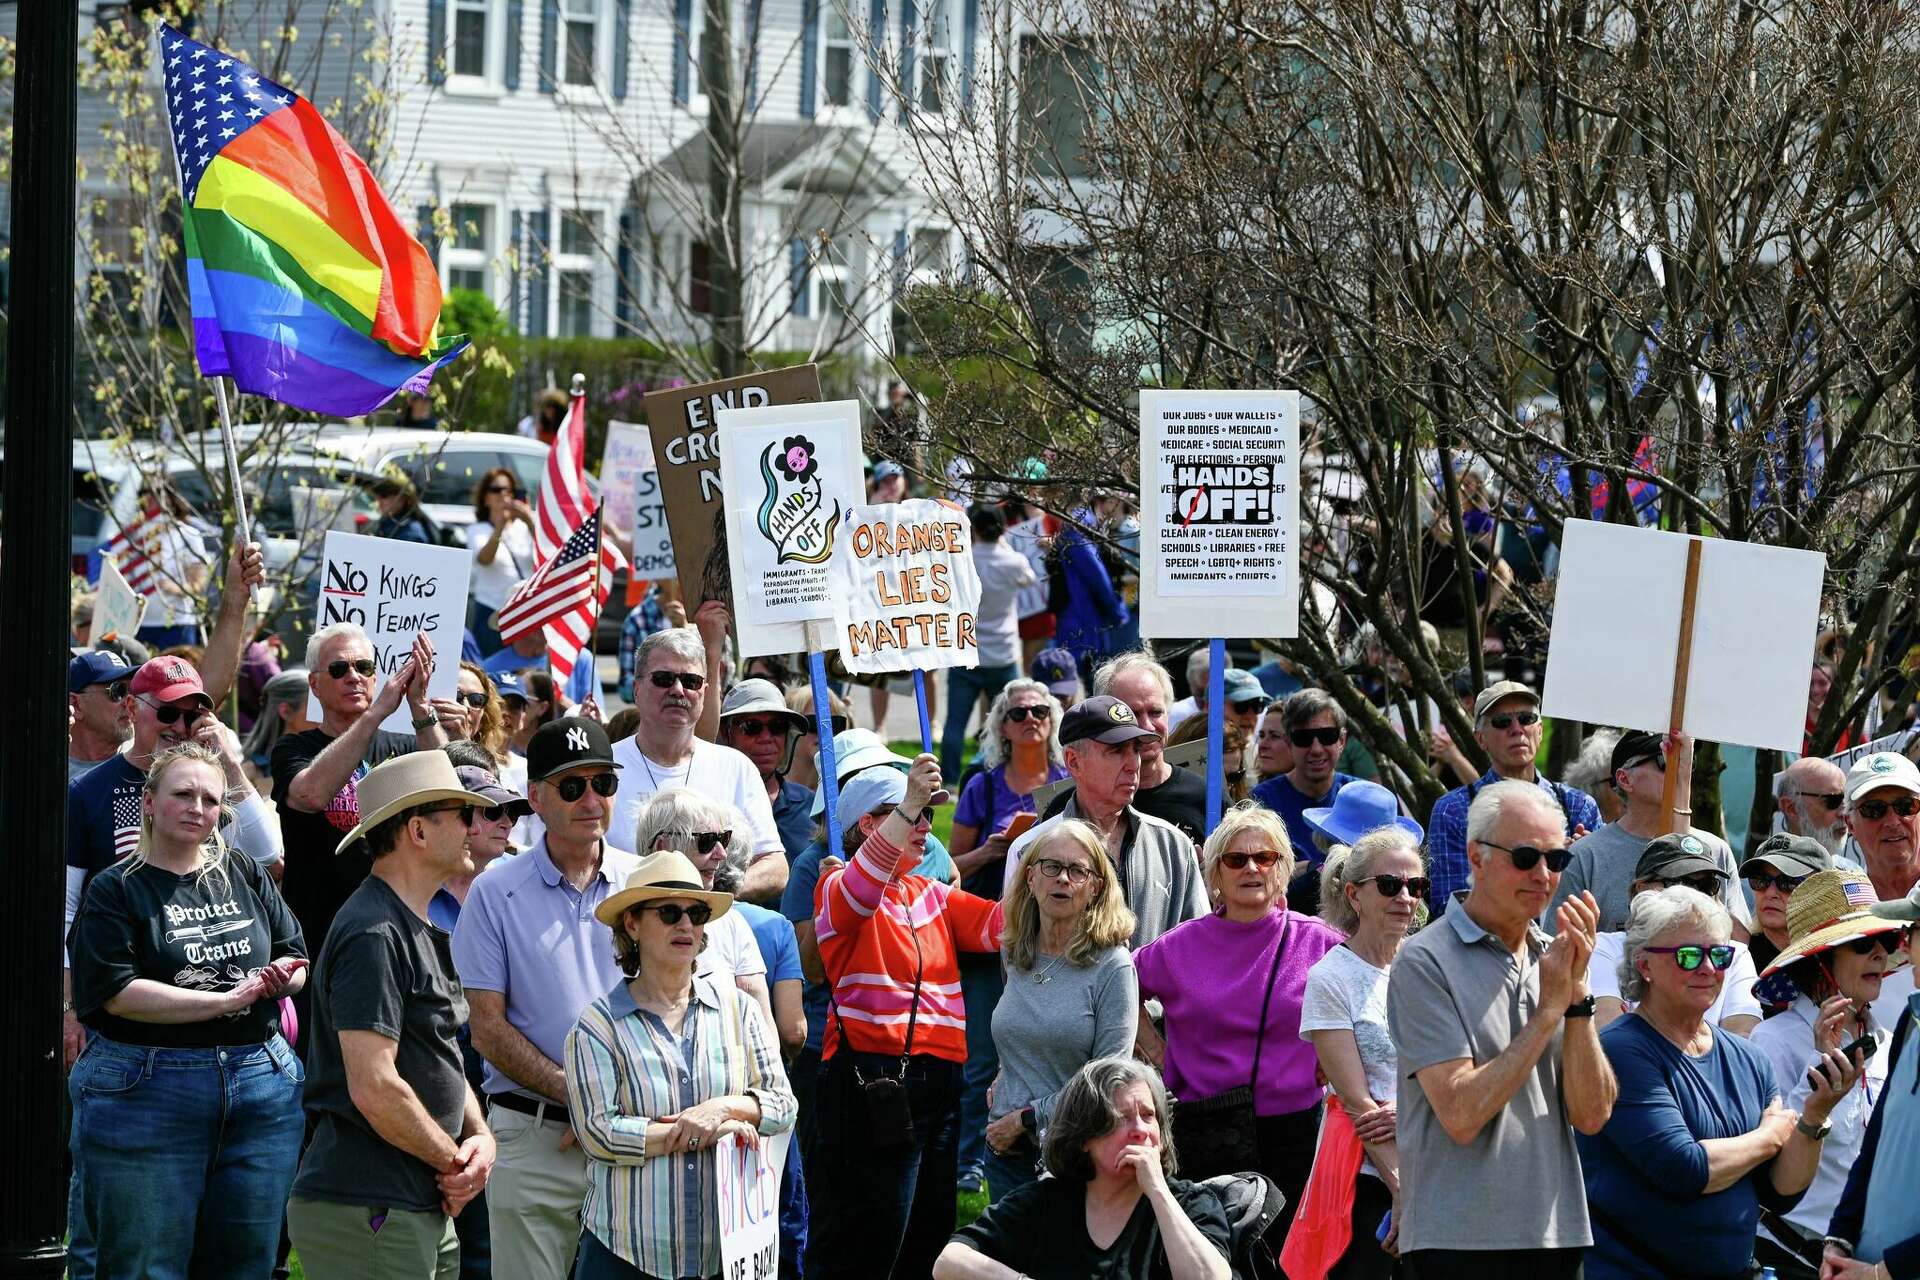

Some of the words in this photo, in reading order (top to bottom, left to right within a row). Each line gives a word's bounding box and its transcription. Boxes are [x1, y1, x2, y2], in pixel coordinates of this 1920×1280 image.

[1167, 425, 1185, 435] OUR
[1187, 425, 1220, 435] BODIES
[1228, 425, 1272, 435] MEDICAID
[1212, 439, 1244, 450] SOCIAL
[1165, 454, 1186, 464] FAIR
[1187, 454, 1234, 464] ELECTIONS
[1243, 454, 1286, 464] PERSONA
[1178, 466, 1270, 487] HANDS
[771, 486, 814, 535] HANDS
[1178, 488, 1270, 521] OFF!
[796, 517, 823, 552] OFF
[1161, 528, 1189, 538] CLEAN
[1190, 528, 1206, 538] AIR
[1215, 528, 1243, 538] CLEAN
[1245, 528, 1279, 538] ENERGY
[852, 521, 964, 559] ORANGE
[1161, 543, 1201, 553] SCHOOLS
[1210, 543, 1256, 553] LIBRARIES
[1264, 543, 1286, 553] FREE
[1165, 558, 1199, 568] SPEECH
[1208, 558, 1241, 568] LGBTQ+
[1243, 558, 1275, 568] RIGHTS
[763, 568, 806, 580] IMMIGRANTS
[763, 578, 801, 589] REPRODUCTIVE
[877, 563, 951, 607] LIES
[765, 588, 780, 597] CIVIL
[780, 587, 800, 596] RIGHTS
[766, 595, 798, 608] LIBRARIES
[800, 593, 825, 603] SCHOOLS
[848, 612, 978, 657] MATTER
[113, 786, 136, 794] OLD
[164, 899, 241, 926] Protect
[184, 936, 251, 964] Trans
